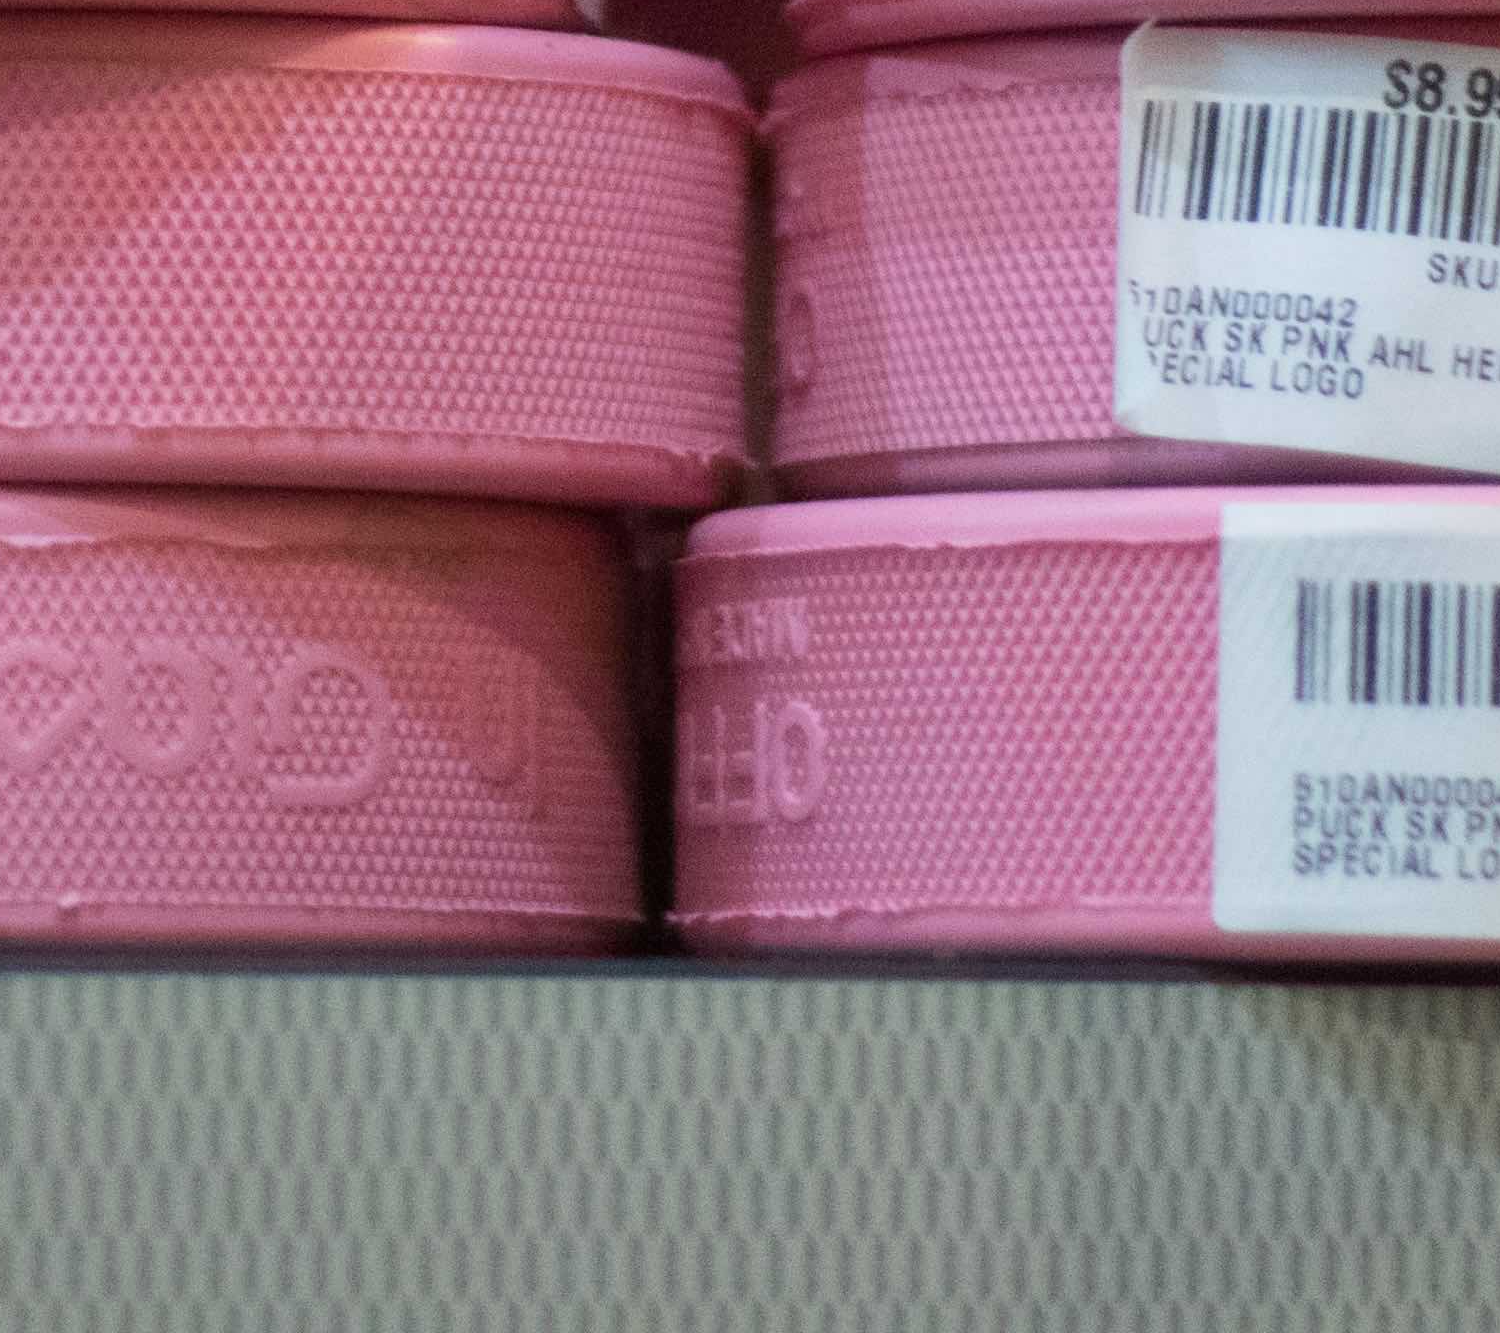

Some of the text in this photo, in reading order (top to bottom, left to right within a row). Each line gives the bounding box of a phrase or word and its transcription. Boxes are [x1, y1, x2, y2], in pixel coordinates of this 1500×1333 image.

[1143, 317, 1208, 353] UCK
[1225, 322, 1267, 356] SK
[1282, 324, 1353, 364] PNK
[1368, 333, 1435, 375] AHL
[1270, 358, 1365, 401] LOGO
[1293, 805, 1388, 841] PUCK
[1405, 809, 1449, 843] SK
[1293, 842, 1442, 878] SPECIAL
